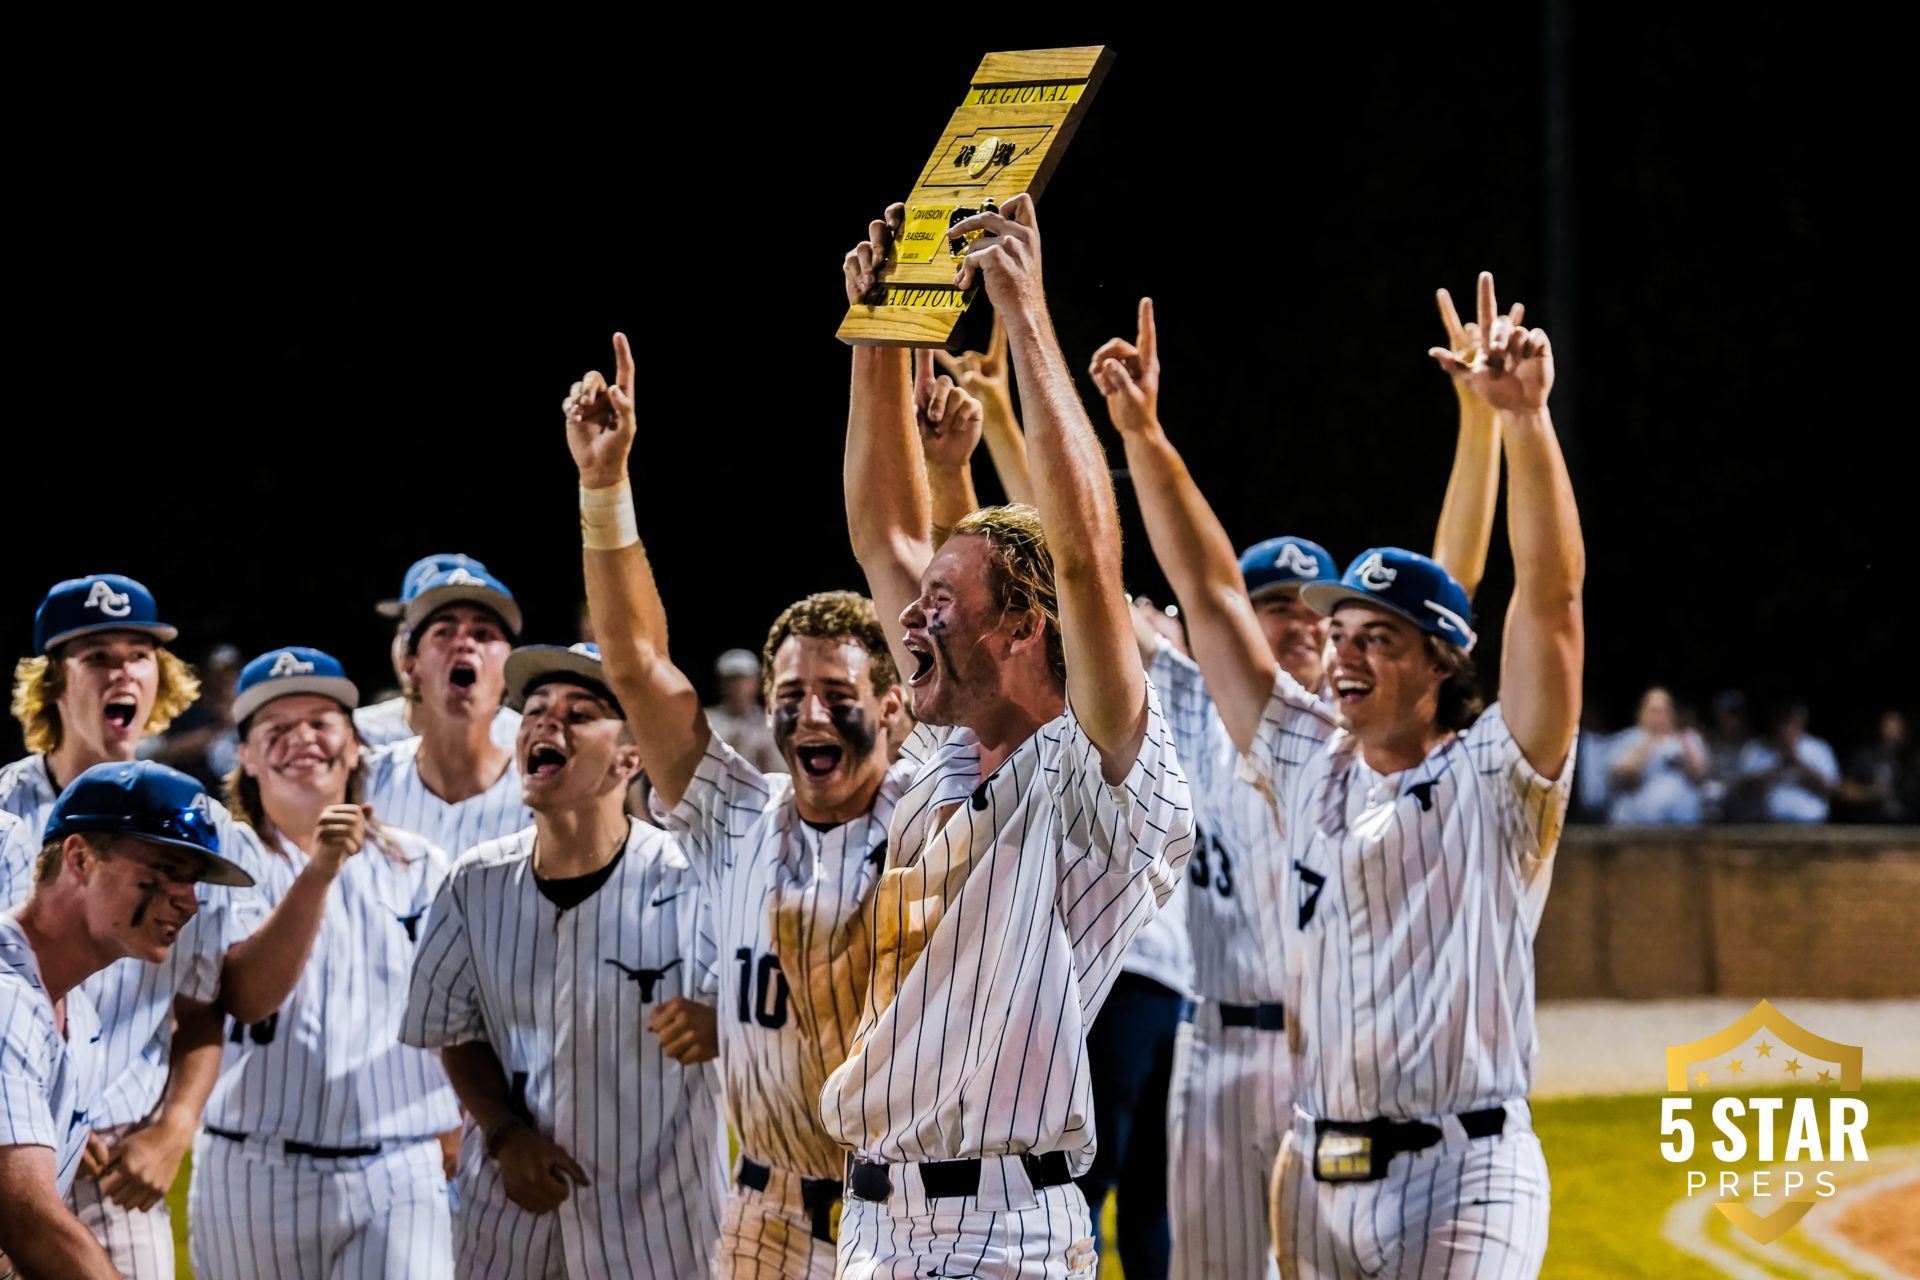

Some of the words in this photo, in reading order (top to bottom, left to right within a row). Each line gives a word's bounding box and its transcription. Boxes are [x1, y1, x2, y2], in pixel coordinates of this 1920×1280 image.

[976, 84, 1069, 104] REGIONAL
[914, 209, 945, 220] DIVISION
[905, 232, 936, 241] BASEBALL
[1275, 543, 1320, 579] AC
[1355, 553, 1398, 591] AC
[85, 580, 131, 617] AC
[1294, 859, 1327, 930] 7
[736, 947, 790, 1029] 10
